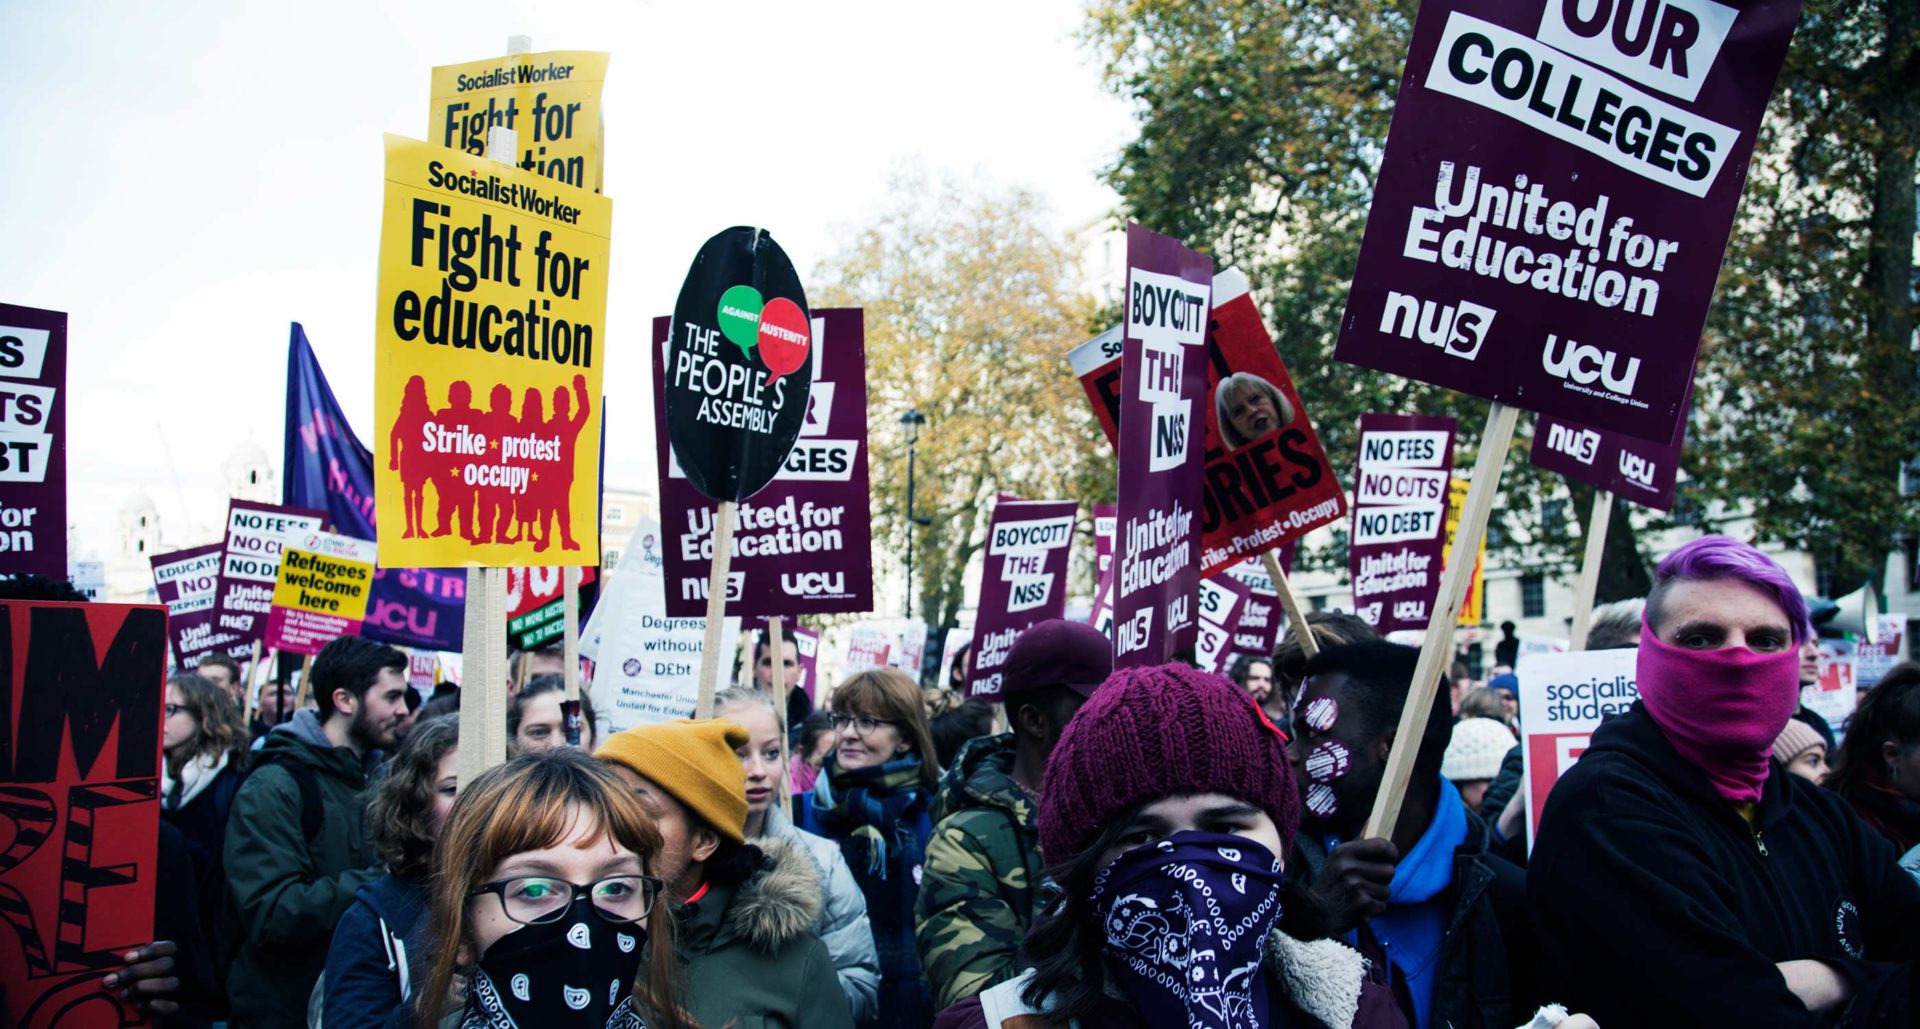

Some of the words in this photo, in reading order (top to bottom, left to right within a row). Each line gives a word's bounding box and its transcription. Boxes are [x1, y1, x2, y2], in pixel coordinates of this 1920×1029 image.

[1561, 0, 1700, 79] OUR
[457, 66, 517, 93] Socialist
[518, 62, 574, 84] Worker
[532, 92, 581, 142] for
[1448, 32, 1717, 182] COLLEGES
[428, 161, 518, 208] Socialist
[519, 184, 581, 225] Worker
[1434, 160, 1610, 248] United
[1606, 217, 1679, 273] for
[411, 198, 521, 292] Fight
[534, 230, 589, 300] for
[1403, 205, 1660, 317] Education
[393, 278, 593, 368] education
[1132, 281, 1204, 333] BOYCOTT
[685, 322, 721, 357] THE
[721, 305, 759, 323] AGAINST
[760, 321, 808, 347] AUSTERITY
[1378, 290, 1497, 361] nus
[1563, 381, 1593, 396] University
[1593, 390, 1605, 398] and
[1605, 392, 1630, 405] College
[1630, 398, 1649, 409] Union
[696, 396, 779, 435] ASSEMBLY
[422, 421, 486, 456] Strike
[502, 432, 561, 463] protest
[1156, 414, 1185, 458] NSS
[1366, 439, 1394, 461] NO
[1397, 438, 1434, 461] FEES
[1547, 423, 1602, 466] nus
[463, 463, 530, 495] occupy
[1364, 474, 1392, 497] NO
[1396, 476, 1440, 499] CUTS
[234, 513, 262, 529] NO
[687, 496, 797, 536] Uited
[800, 502, 845, 528] for
[1126, 499, 1178, 558] United
[1232, 520, 1285, 554] Protest
[1289, 497, 1340, 528] Occupy
[1360, 514, 1388, 536] NO
[1392, 511, 1434, 535] DEBT
[233, 535, 262, 551] NO
[681, 524, 843, 561] Edcation
[995, 523, 1068, 547] BOYCOTT
[229, 559, 257, 575] NO
[286, 551, 366, 580] Refugees
[1009, 556, 1039, 575] THE
[1121, 537, 1190, 599] Education
[1360, 548, 1407, 577] United
[1407, 551, 1431, 571] for
[285, 572, 361, 597] welcome
[1013, 582, 1045, 605] NSS
[1355, 570, 1428, 597] Education
[299, 590, 339, 611] here
[642, 615, 706, 631] Degrees
[644, 638, 703, 653] without
[655, 662, 691, 676] D£bt
[616, 700, 646, 711] United
[622, 687, 673, 701] Manchester
